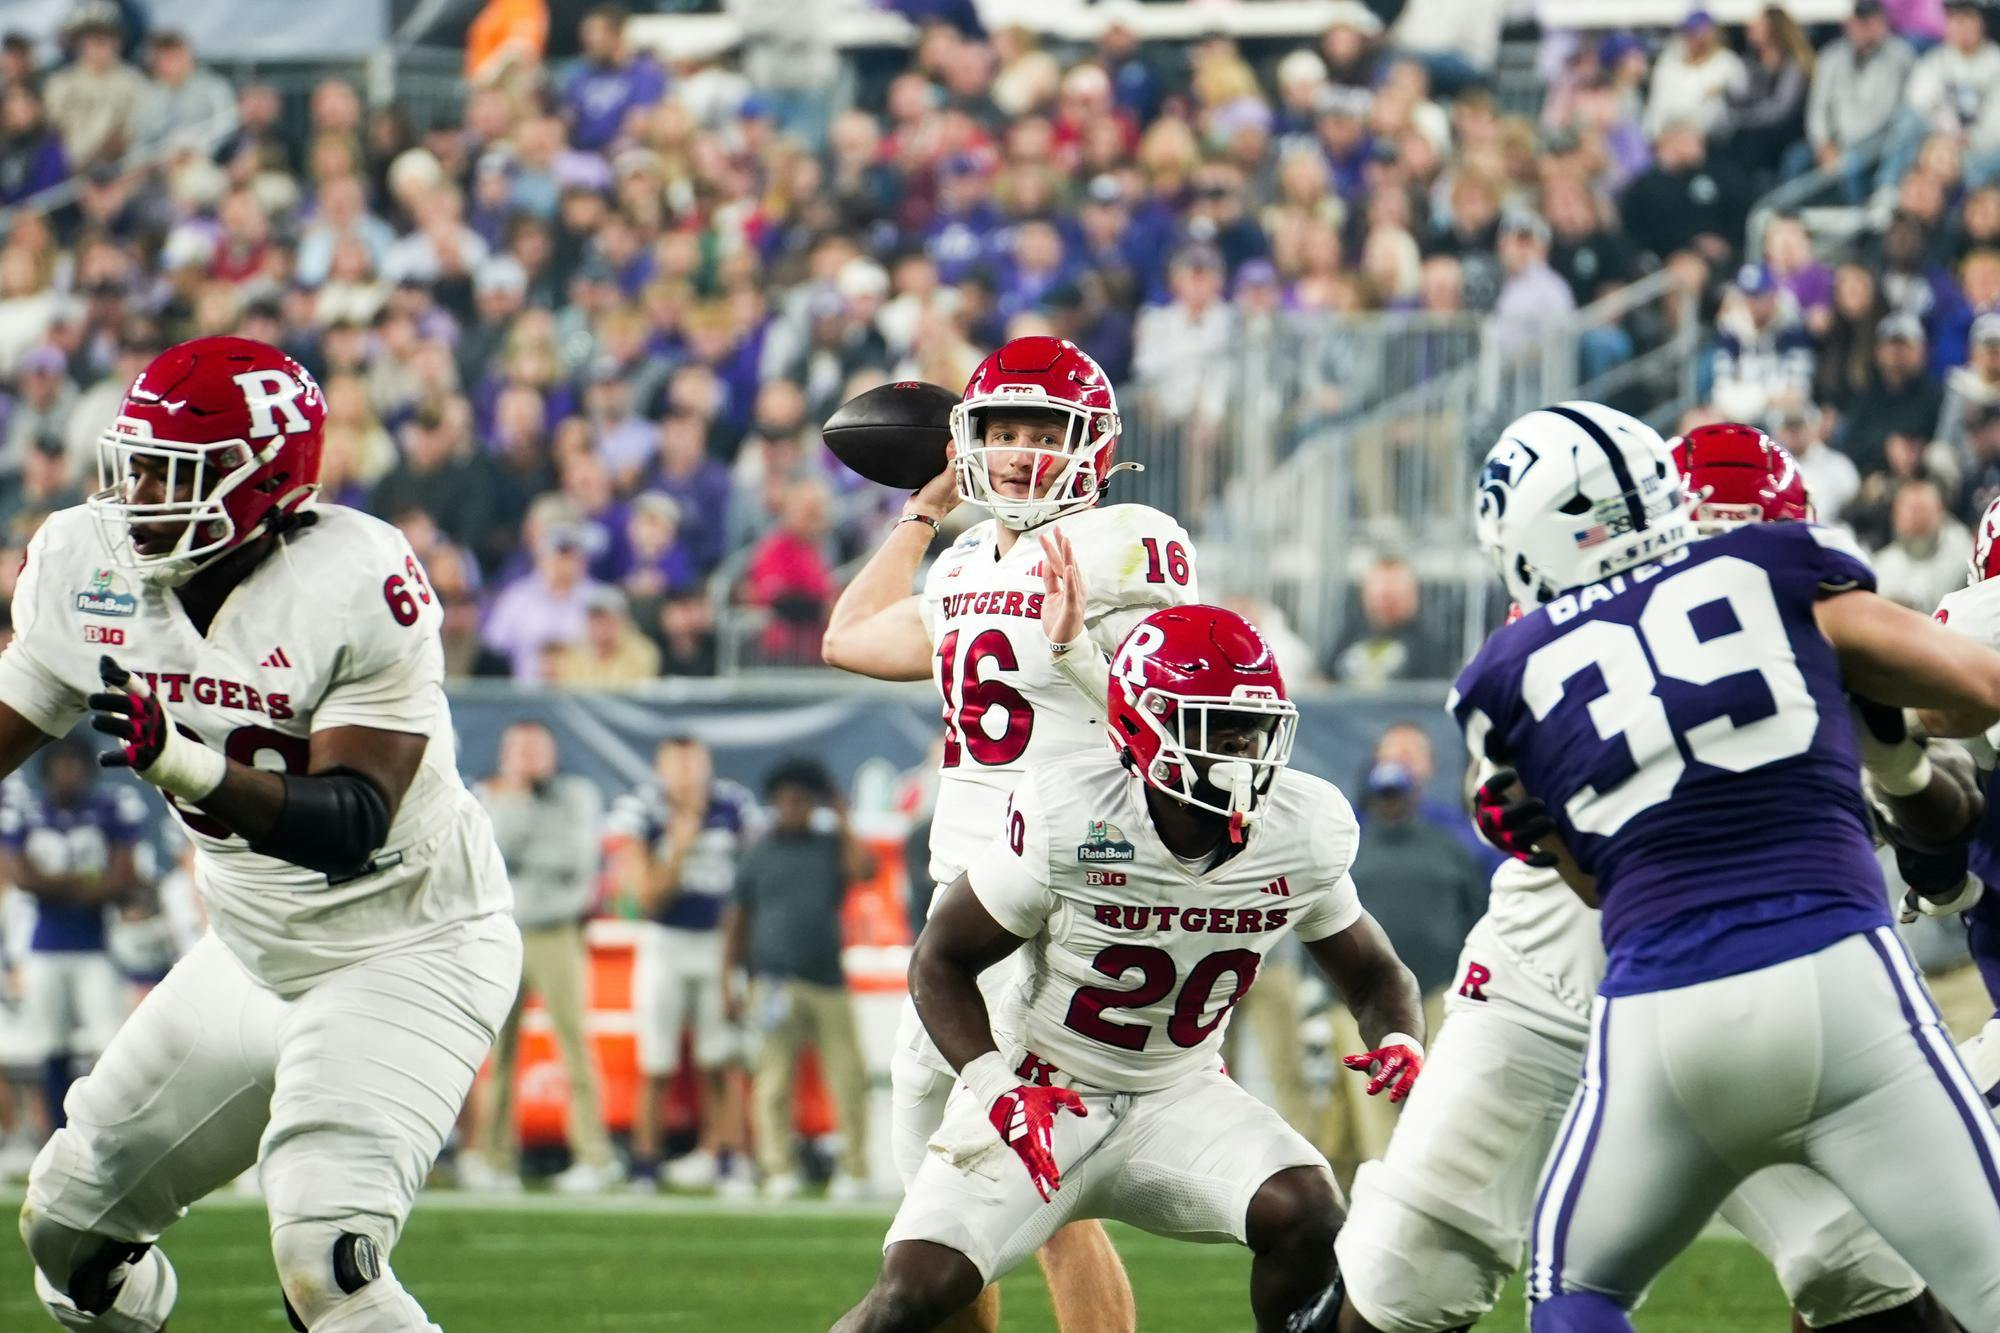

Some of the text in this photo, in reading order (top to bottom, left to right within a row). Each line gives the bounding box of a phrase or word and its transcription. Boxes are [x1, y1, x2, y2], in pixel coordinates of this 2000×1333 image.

[232, 369, 311, 439] R
[1142, 537, 1190, 587] 16
[942, 590, 1046, 621] RUTGERS
[1110, 622, 1166, 688] R
[131, 670, 295, 720] TGERS
[936, 628, 1035, 769] 16
[1521, 554, 1819, 838] 39
[1006, 790, 1026, 858] 0
[1093, 904, 1289, 934] RUTGERS
[1063, 943, 1262, 1053] 20
[1457, 960, 1491, 1003] R
